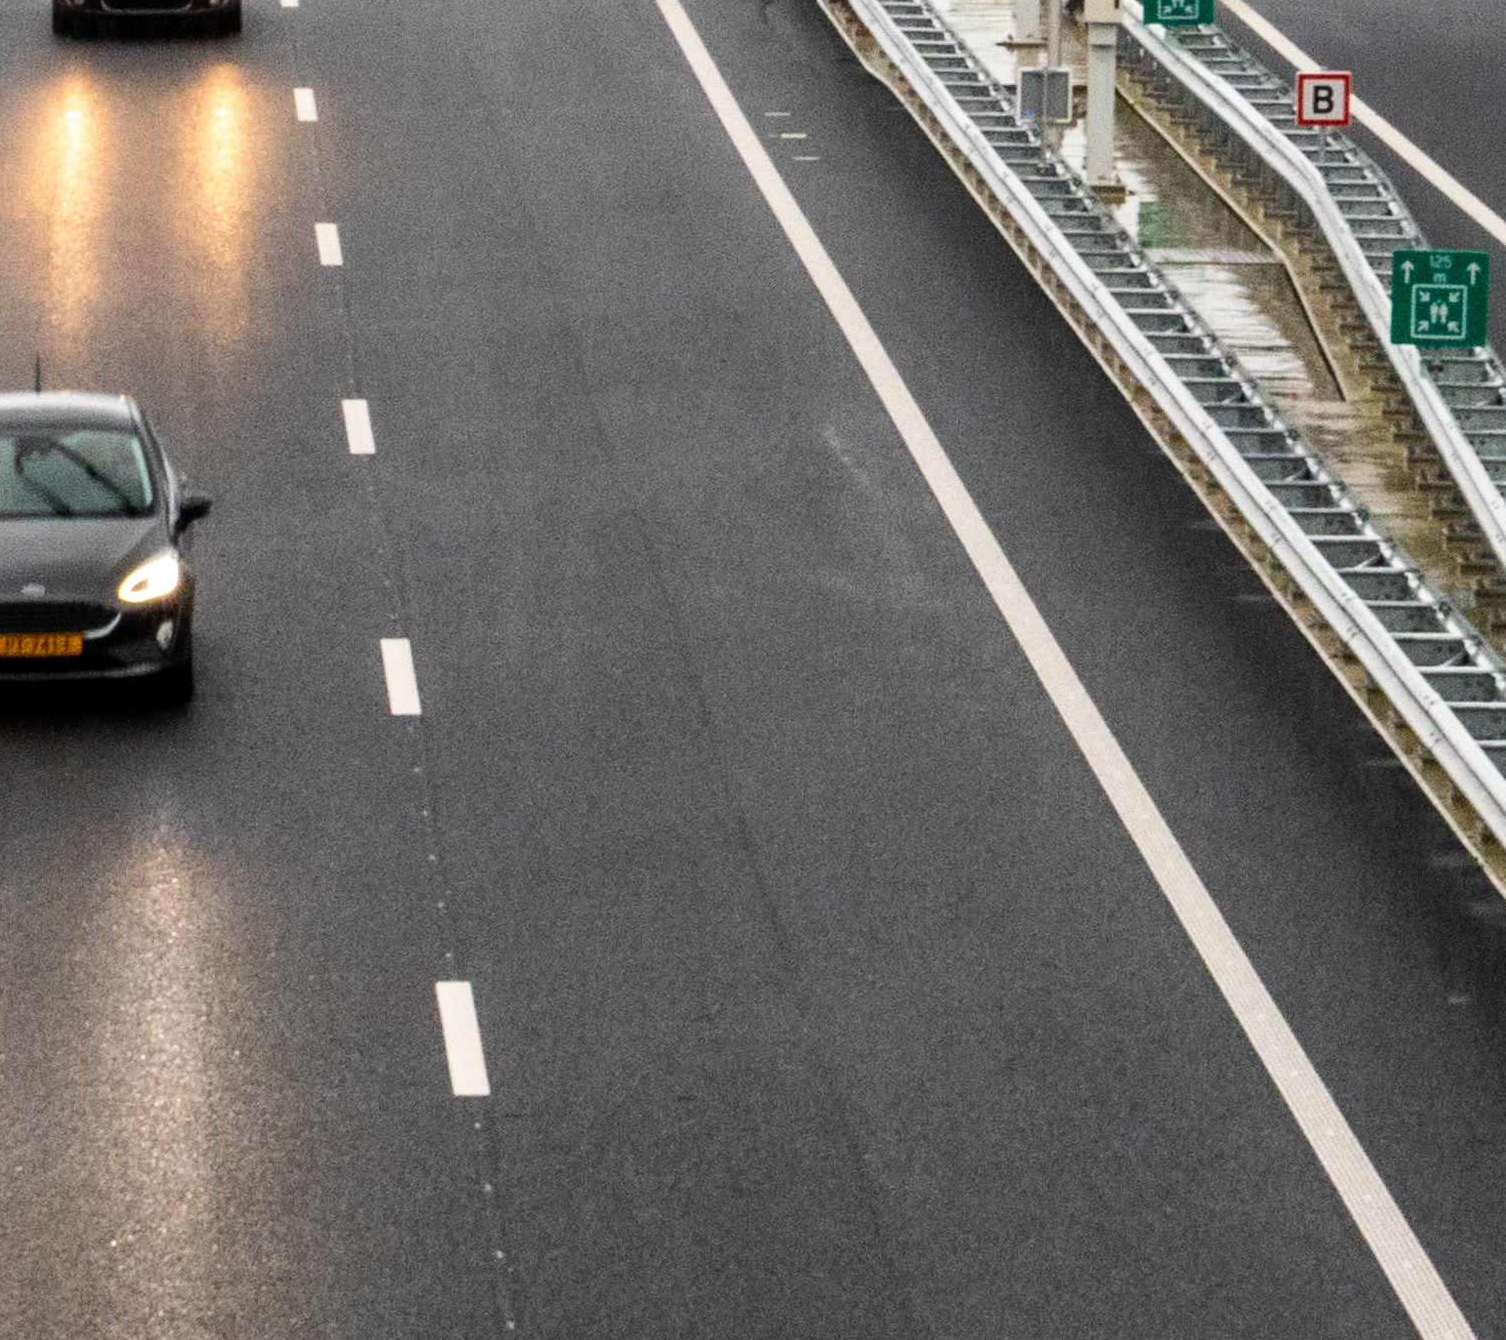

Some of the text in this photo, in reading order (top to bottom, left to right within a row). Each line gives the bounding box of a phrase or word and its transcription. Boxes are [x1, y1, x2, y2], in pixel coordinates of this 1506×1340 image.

[1312, 85, 1334, 114] B
[1428, 255, 1452, 269] 125
[1432, 272, 1448, 283] m
